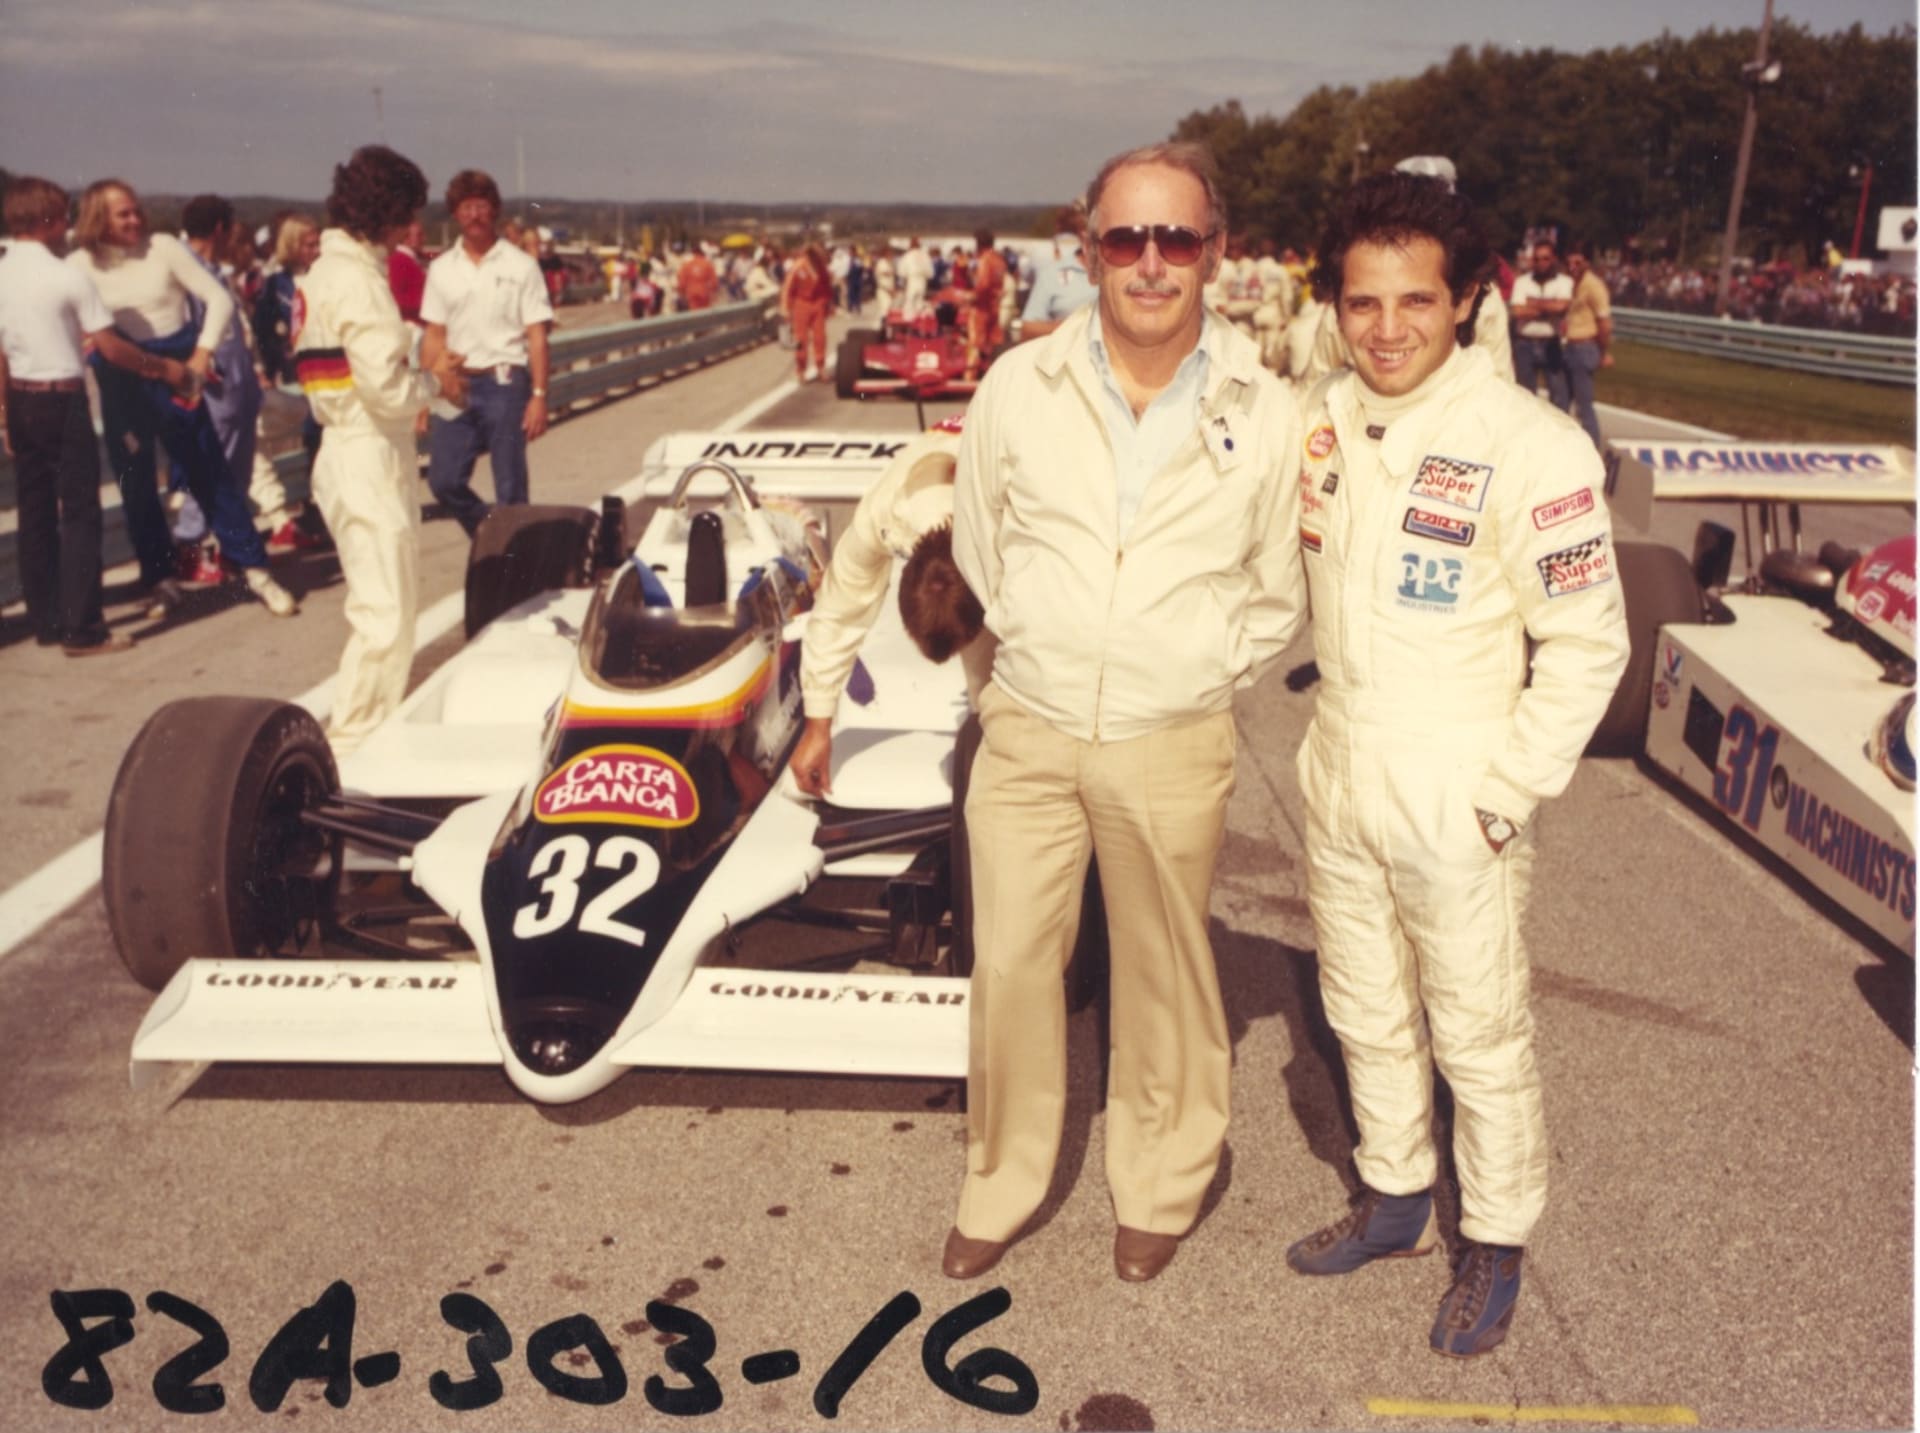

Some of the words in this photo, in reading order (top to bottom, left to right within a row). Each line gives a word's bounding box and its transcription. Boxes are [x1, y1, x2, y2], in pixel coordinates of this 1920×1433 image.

[700, 442, 909, 459] INDECK
[1424, 463, 1477, 494] Super
[1541, 493, 1591, 522] SIMPSON
[1551, 553, 1608, 583] Super
[566, 758, 677, 793] CARTA
[544, 783, 679, 820] BLANCA
[1712, 702, 1780, 833] 31
[1785, 782, 1916, 922] MACHINISTS
[512, 834, 661, 948] 32
[206, 971, 458, 990] GOODYEAR
